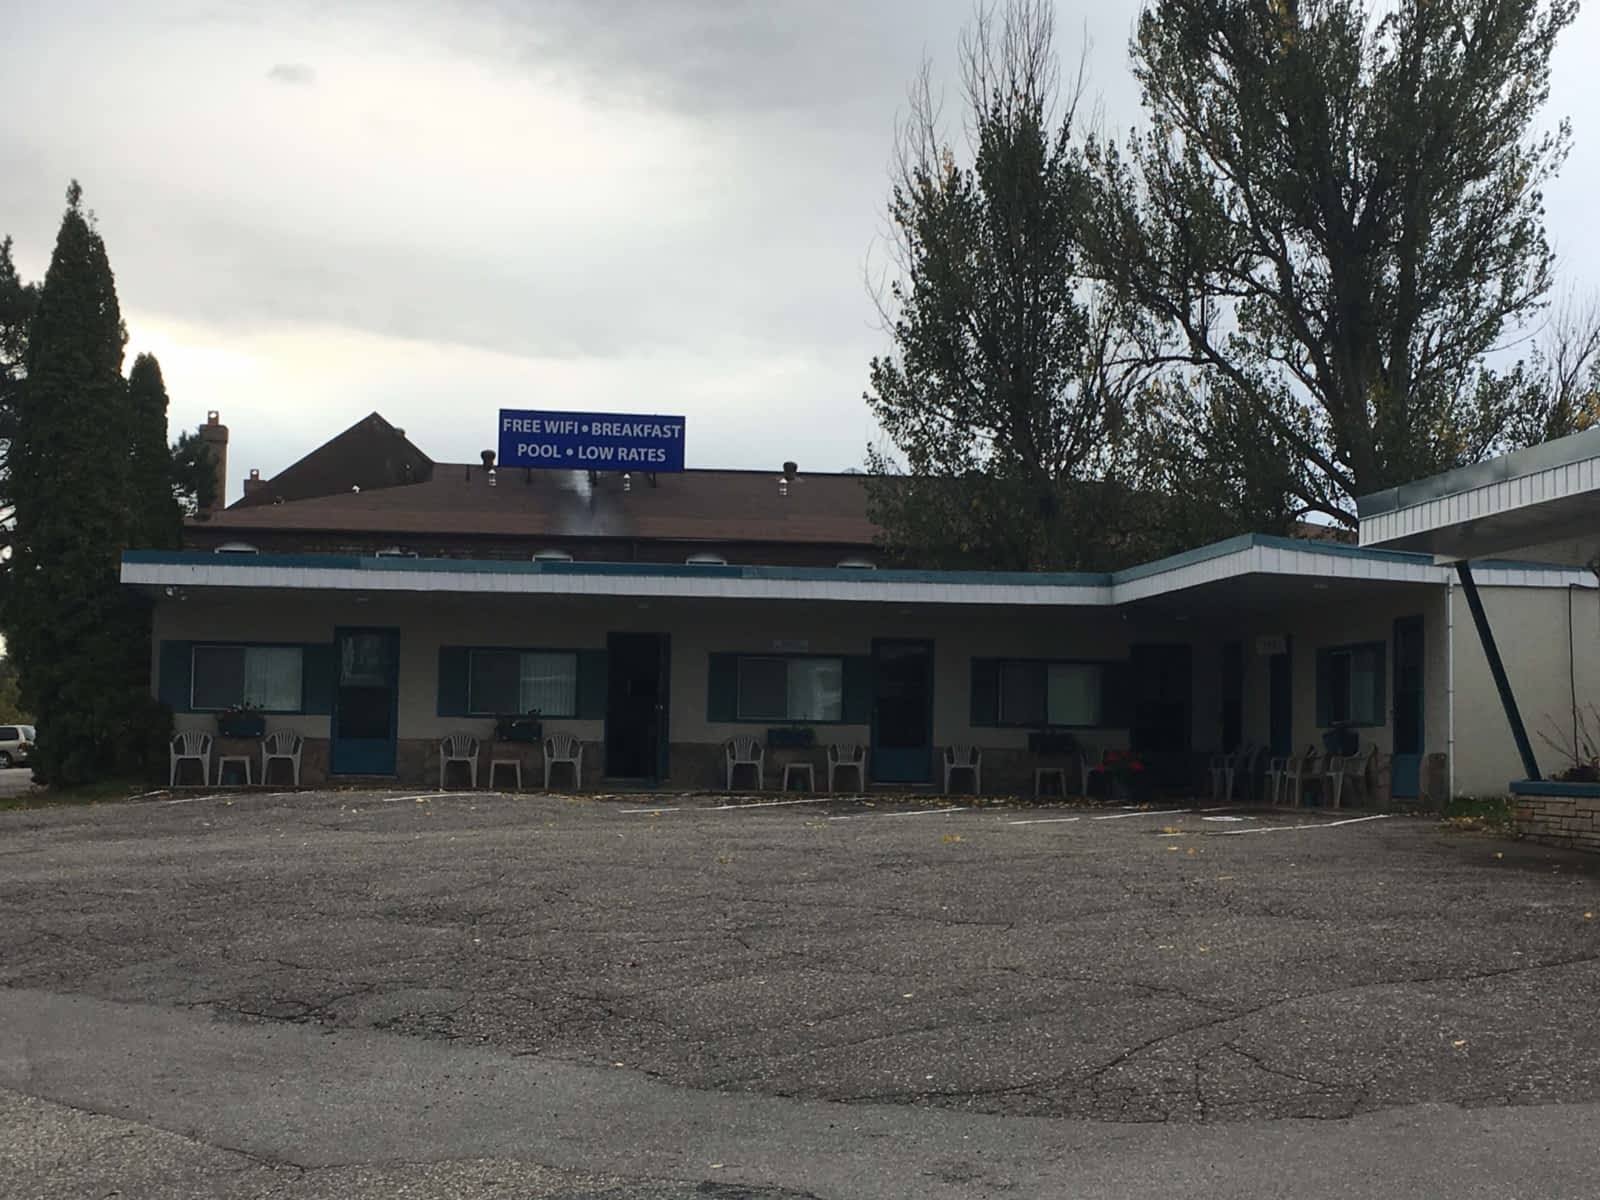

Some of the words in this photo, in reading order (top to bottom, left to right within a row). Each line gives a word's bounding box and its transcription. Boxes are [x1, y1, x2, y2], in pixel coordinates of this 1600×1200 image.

[503, 418, 541, 433] FREE
[544, 420, 579, 435] WIFI
[591, 422, 681, 439] BREAKFAST
[517, 443, 562, 458] POOL
[578, 445, 614, 460] LOW
[617, 447, 667, 462] RATES
